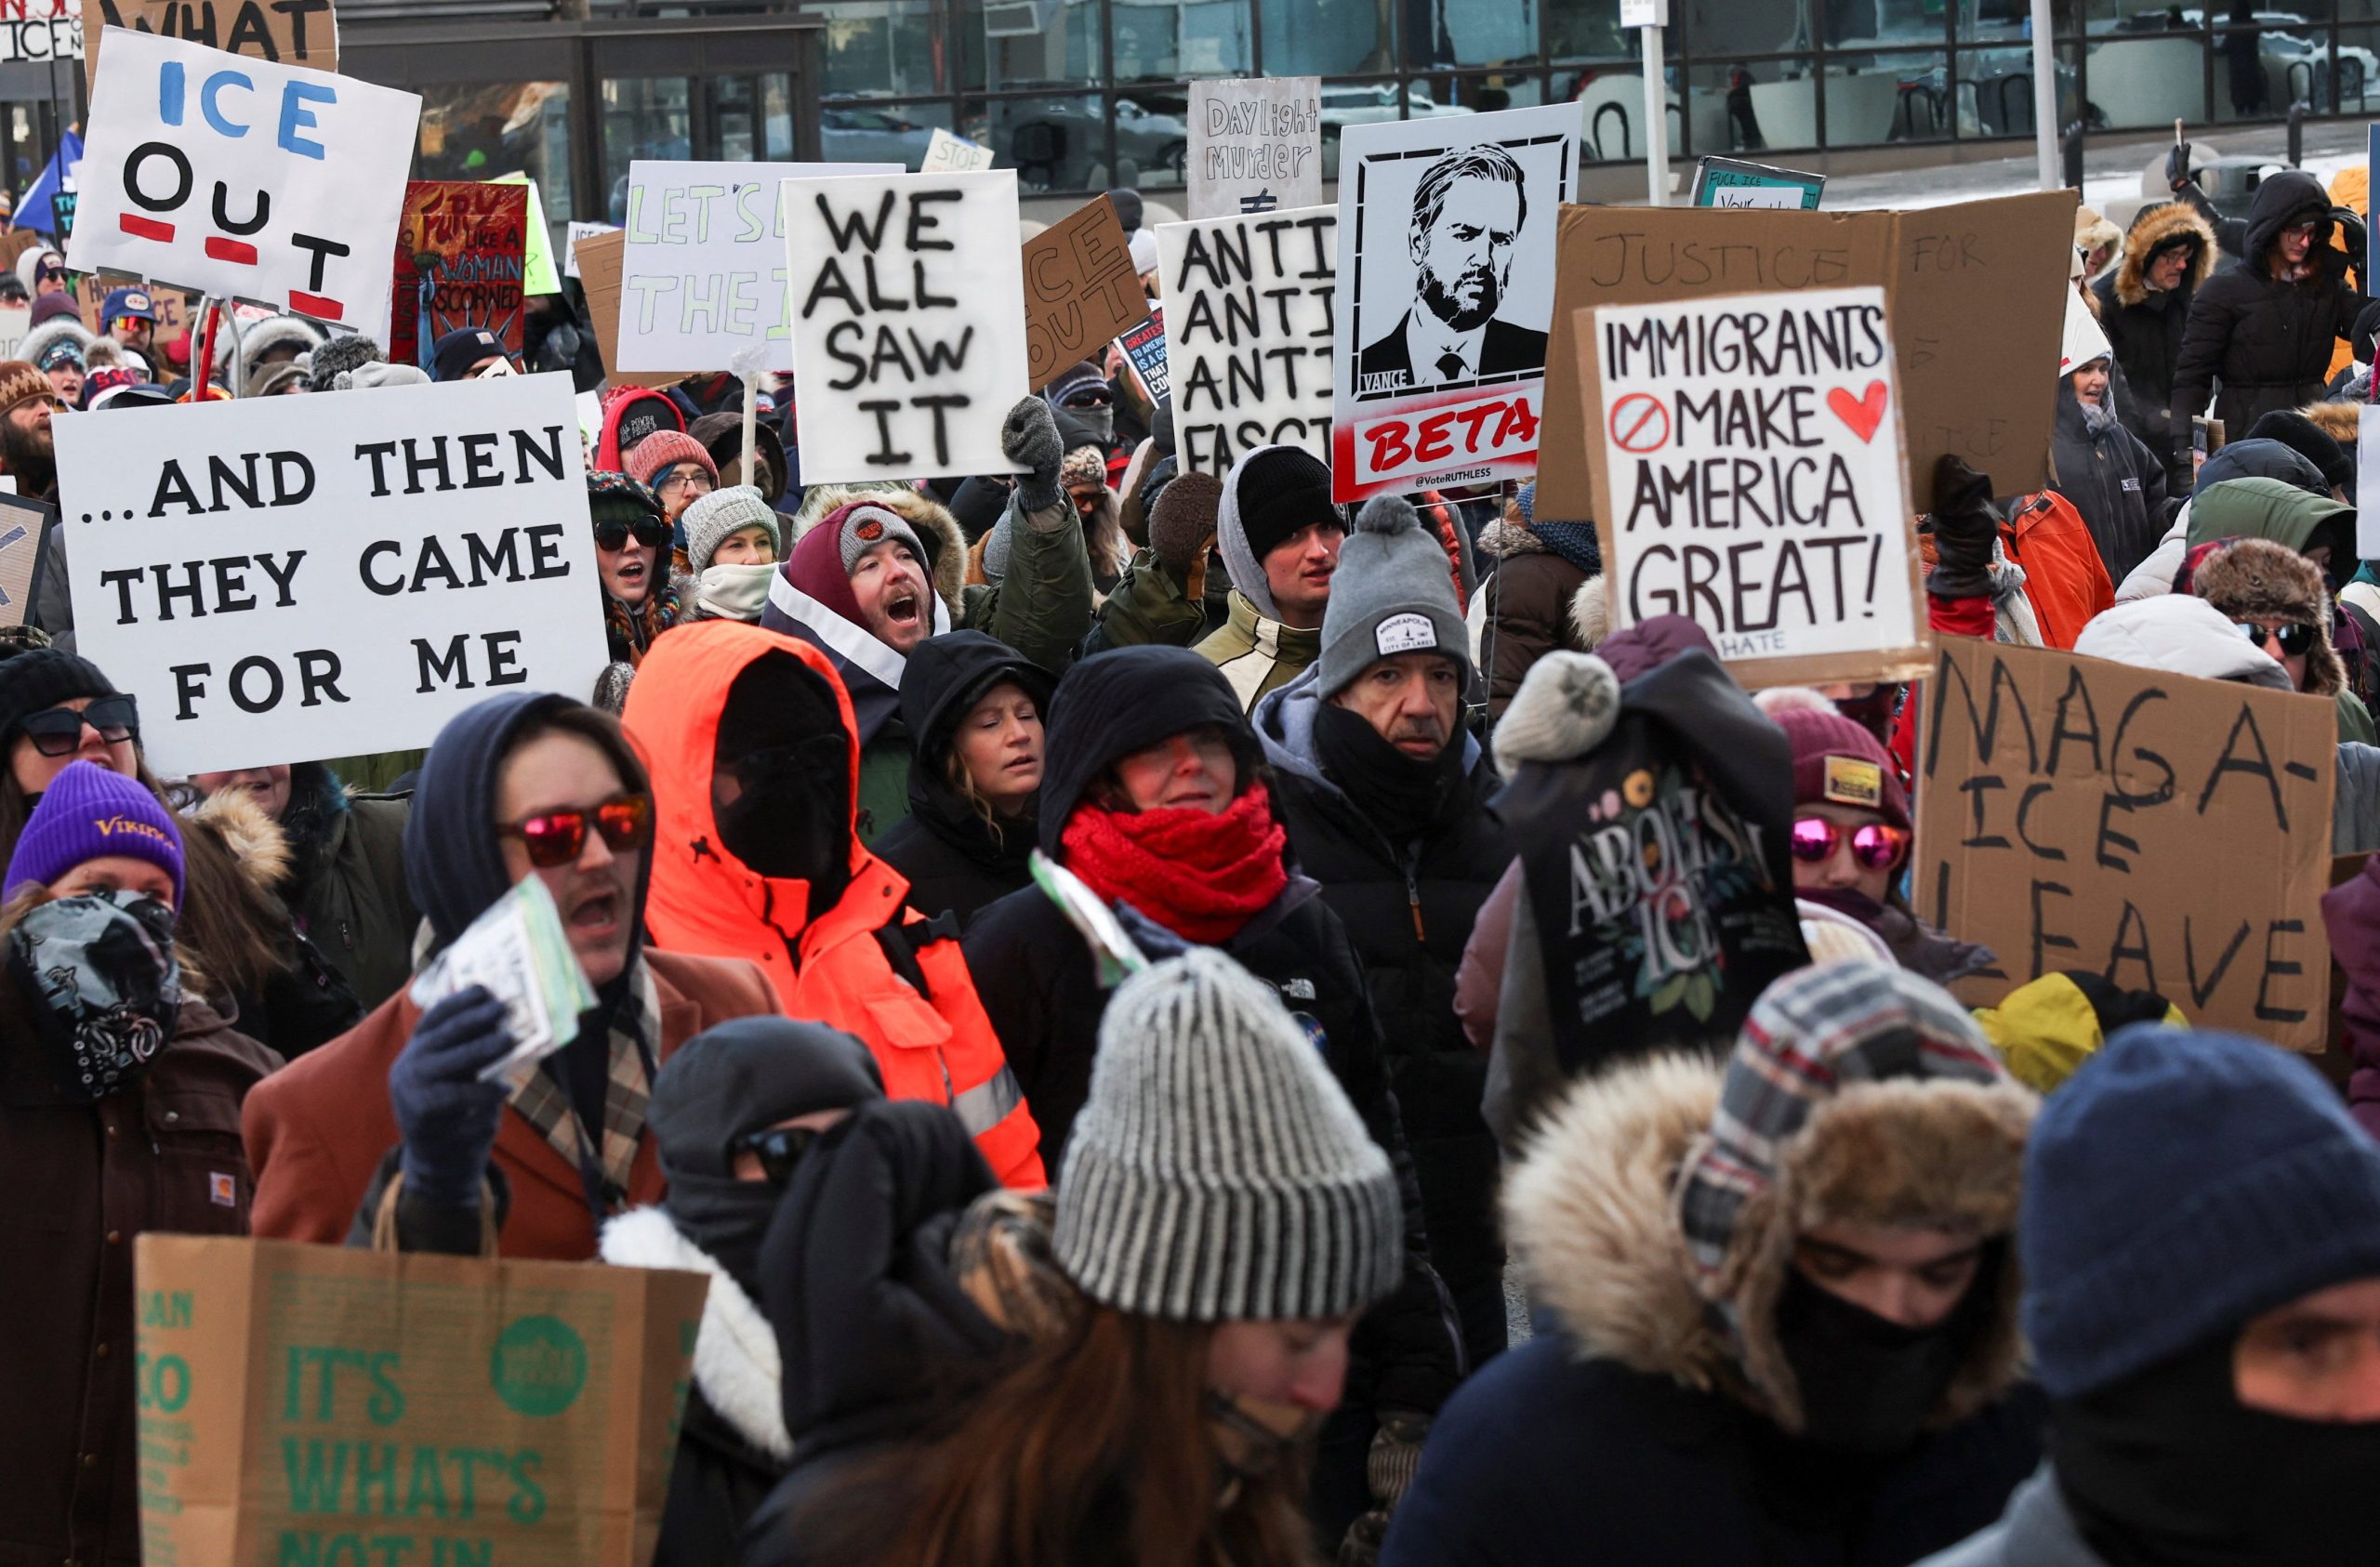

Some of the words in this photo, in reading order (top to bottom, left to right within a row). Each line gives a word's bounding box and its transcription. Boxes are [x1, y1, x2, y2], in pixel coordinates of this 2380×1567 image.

[0, 19, 73, 62] ICE
[160, 61, 337, 160] ICE
[935, 141, 981, 170] STOP
[1709, 171, 1738, 185] FUCK
[1741, 176, 1762, 186] ICE
[124, 141, 350, 292] OUT
[504, 229, 520, 250] A
[815, 190, 963, 253] WE
[439, 252, 522, 283] WOMAN
[801, 256, 958, 318] ALL
[1025, 208, 1122, 311] CE
[1177, 217, 1337, 293] ANTI
[1591, 233, 1848, 288] JUSTICE
[1913, 234, 1986, 271] FOR
[433, 284, 523, 311] SCORNED
[1026, 259, 1132, 378] OUT
[1180, 285, 1335, 347] ANTI
[826, 321, 974, 390] SAW
[1130, 349, 1143, 359] TO
[1137, 357, 1149, 371] IS
[1148, 354, 1157, 365] A
[1144, 362, 1167, 381] THAT
[1606, 305, 1885, 381] IMMIGRANTS
[1363, 370, 1408, 392] VANCE
[859, 393, 970, 466] IT
[1363, 397, 1540, 473] BETA
[1674, 386, 1824, 449] MAKE
[354, 425, 565, 498] THEN
[1415, 467, 1491, 487] @VoteRUTHLESS
[1626, 454, 1864, 533] AMERICA
[100, 549, 308, 625] THEY
[359, 523, 571, 596] CAME
[1629, 533, 1883, 632] GREAT!
[1380, 617, 1430, 634] MINNEAPOLIS
[1720, 632, 1786, 655] HATE
[169, 648, 350, 720] FOR
[409, 629, 528, 694] ME
[1960, 775, 2141, 874] ICE
[1937, 861, 2307, 1022] LEAVE
[284, 1345, 405, 1426] IT'S
[281, 1438, 546, 1525] WHAT'S
